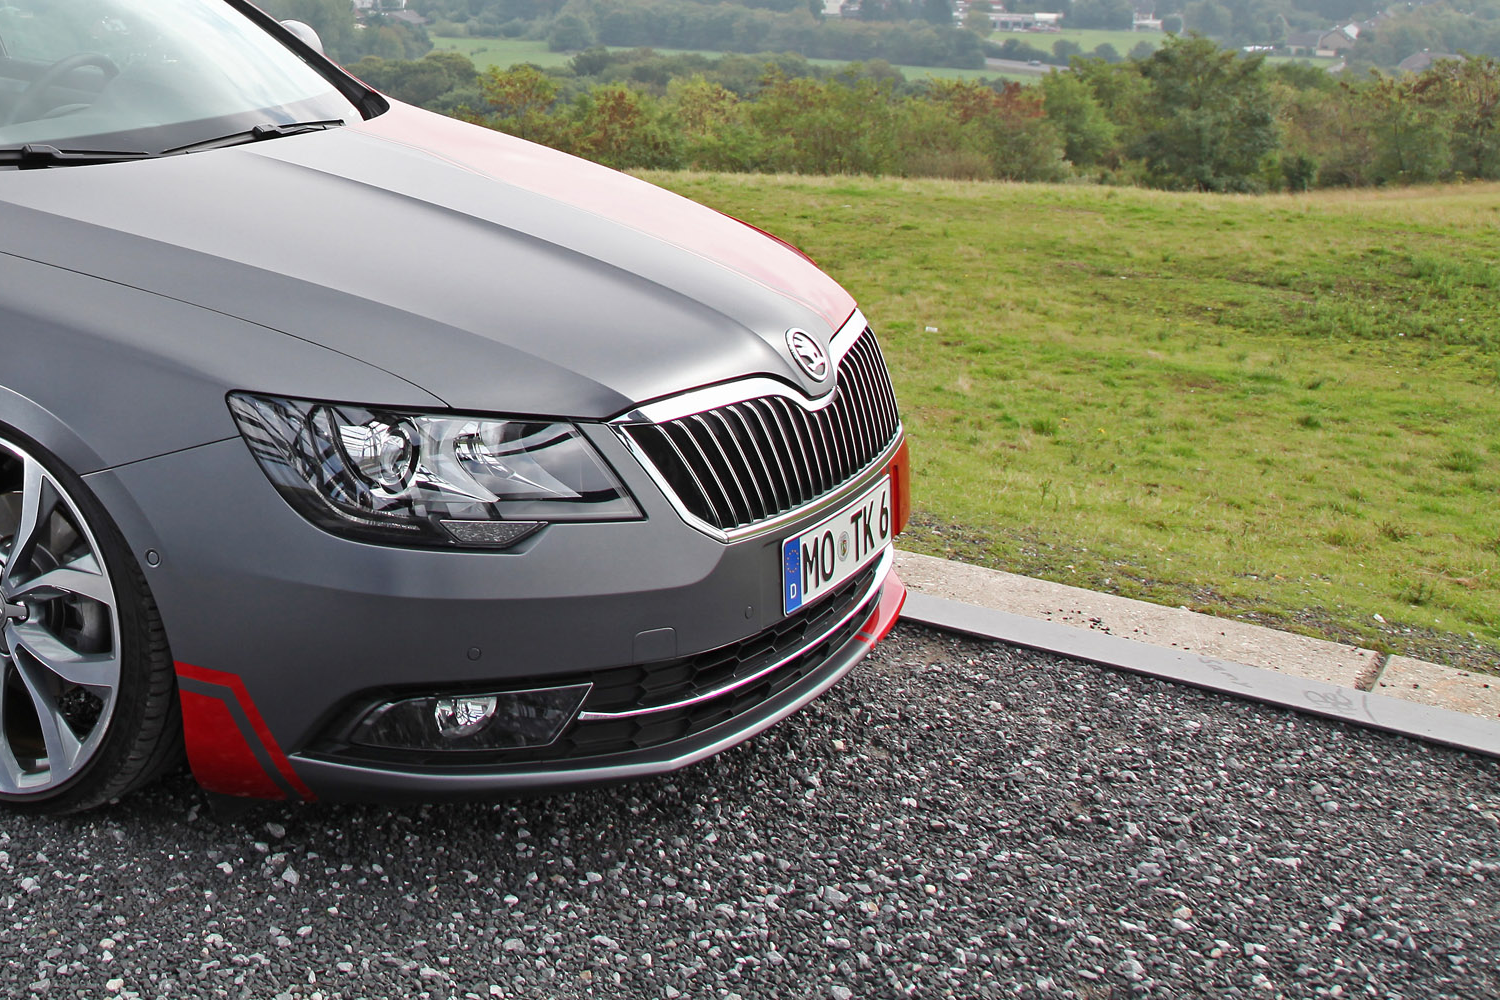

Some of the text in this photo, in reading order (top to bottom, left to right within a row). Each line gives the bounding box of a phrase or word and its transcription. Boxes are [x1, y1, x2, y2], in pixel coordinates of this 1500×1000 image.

[802, 489, 889, 595] MO TK 6
[790, 583, 797, 599] D
